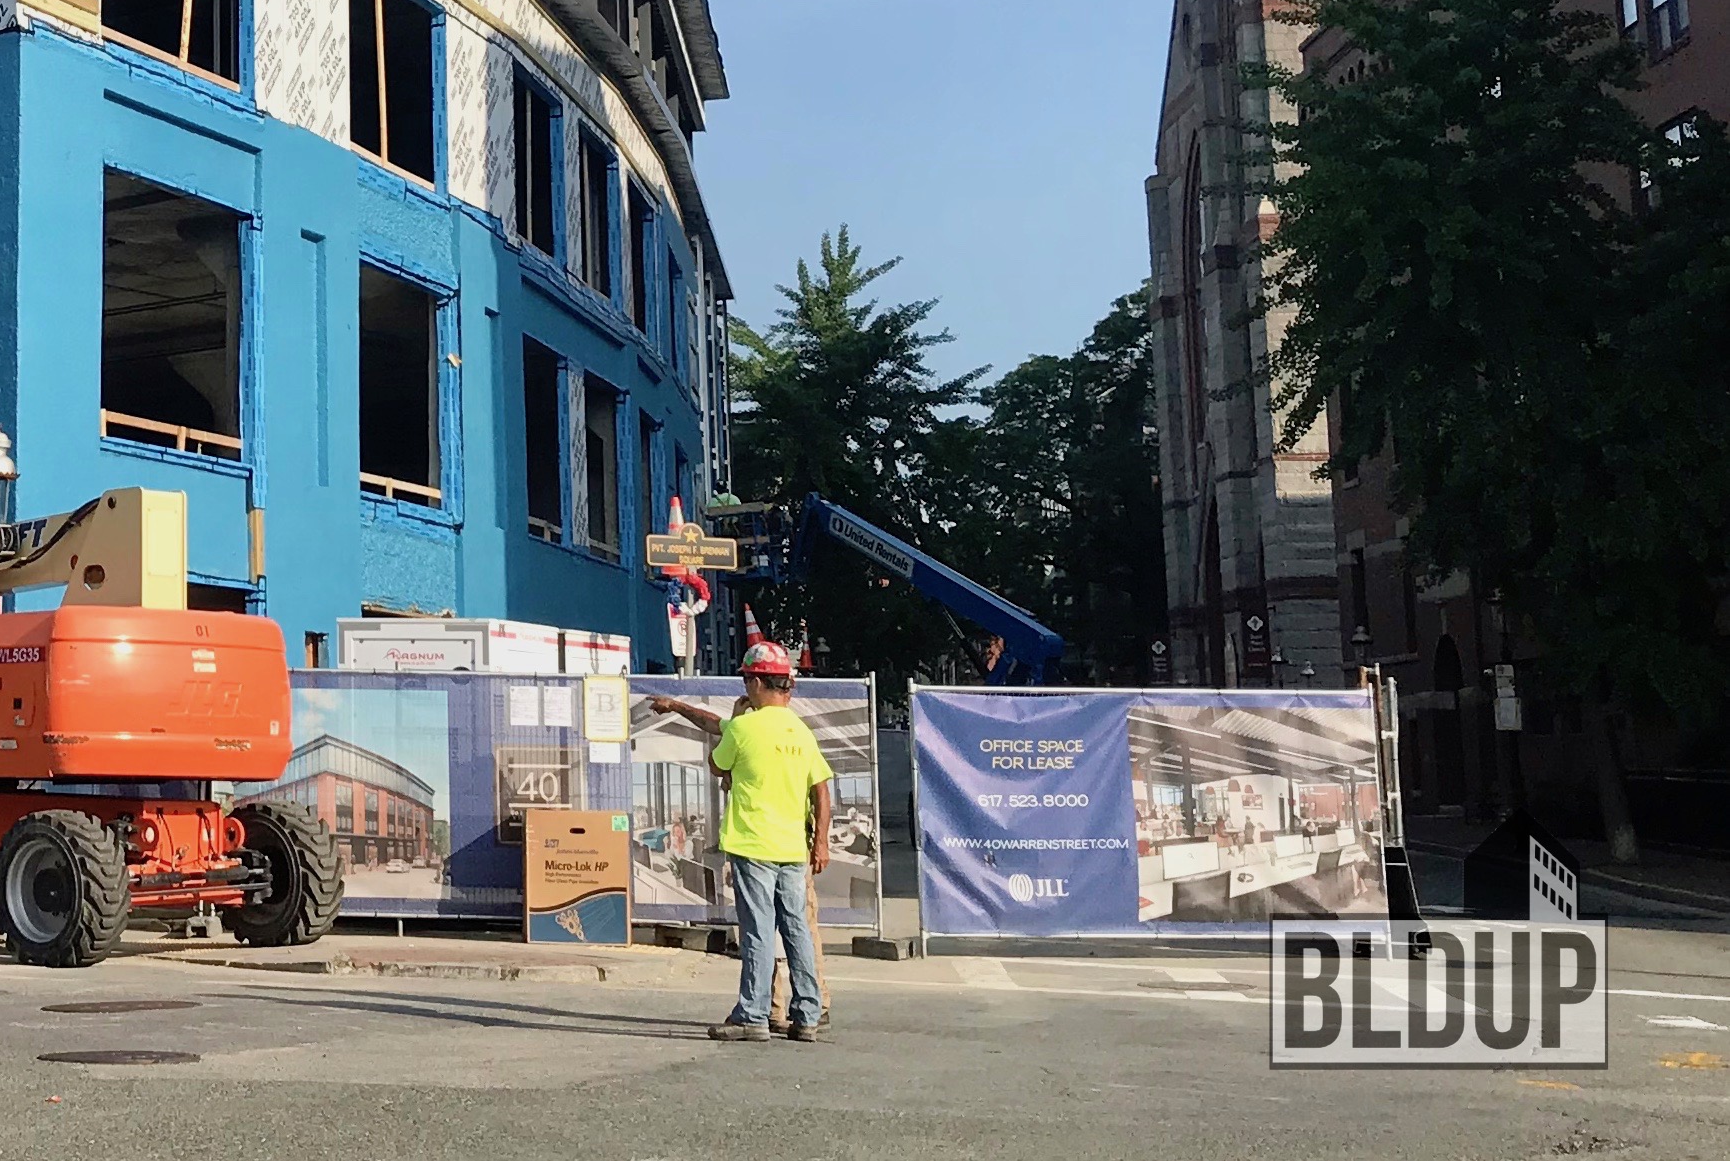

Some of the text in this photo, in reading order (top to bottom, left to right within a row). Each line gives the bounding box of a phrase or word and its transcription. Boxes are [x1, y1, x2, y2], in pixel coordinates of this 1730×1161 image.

[845, 524, 910, 571] United Rentals
[979, 739, 1085, 753] OFFICE SPACE
[992, 756, 1075, 770] FOR LEASE
[516, 771, 559, 802] 40
[977, 793, 1089, 808] 617.523.8000
[943, 836, 1129, 850] WWW.40WARRENSTREET.COM
[544, 860, 610, 872] Micro-Lok HP
[1035, 878, 1069, 897] JLL
